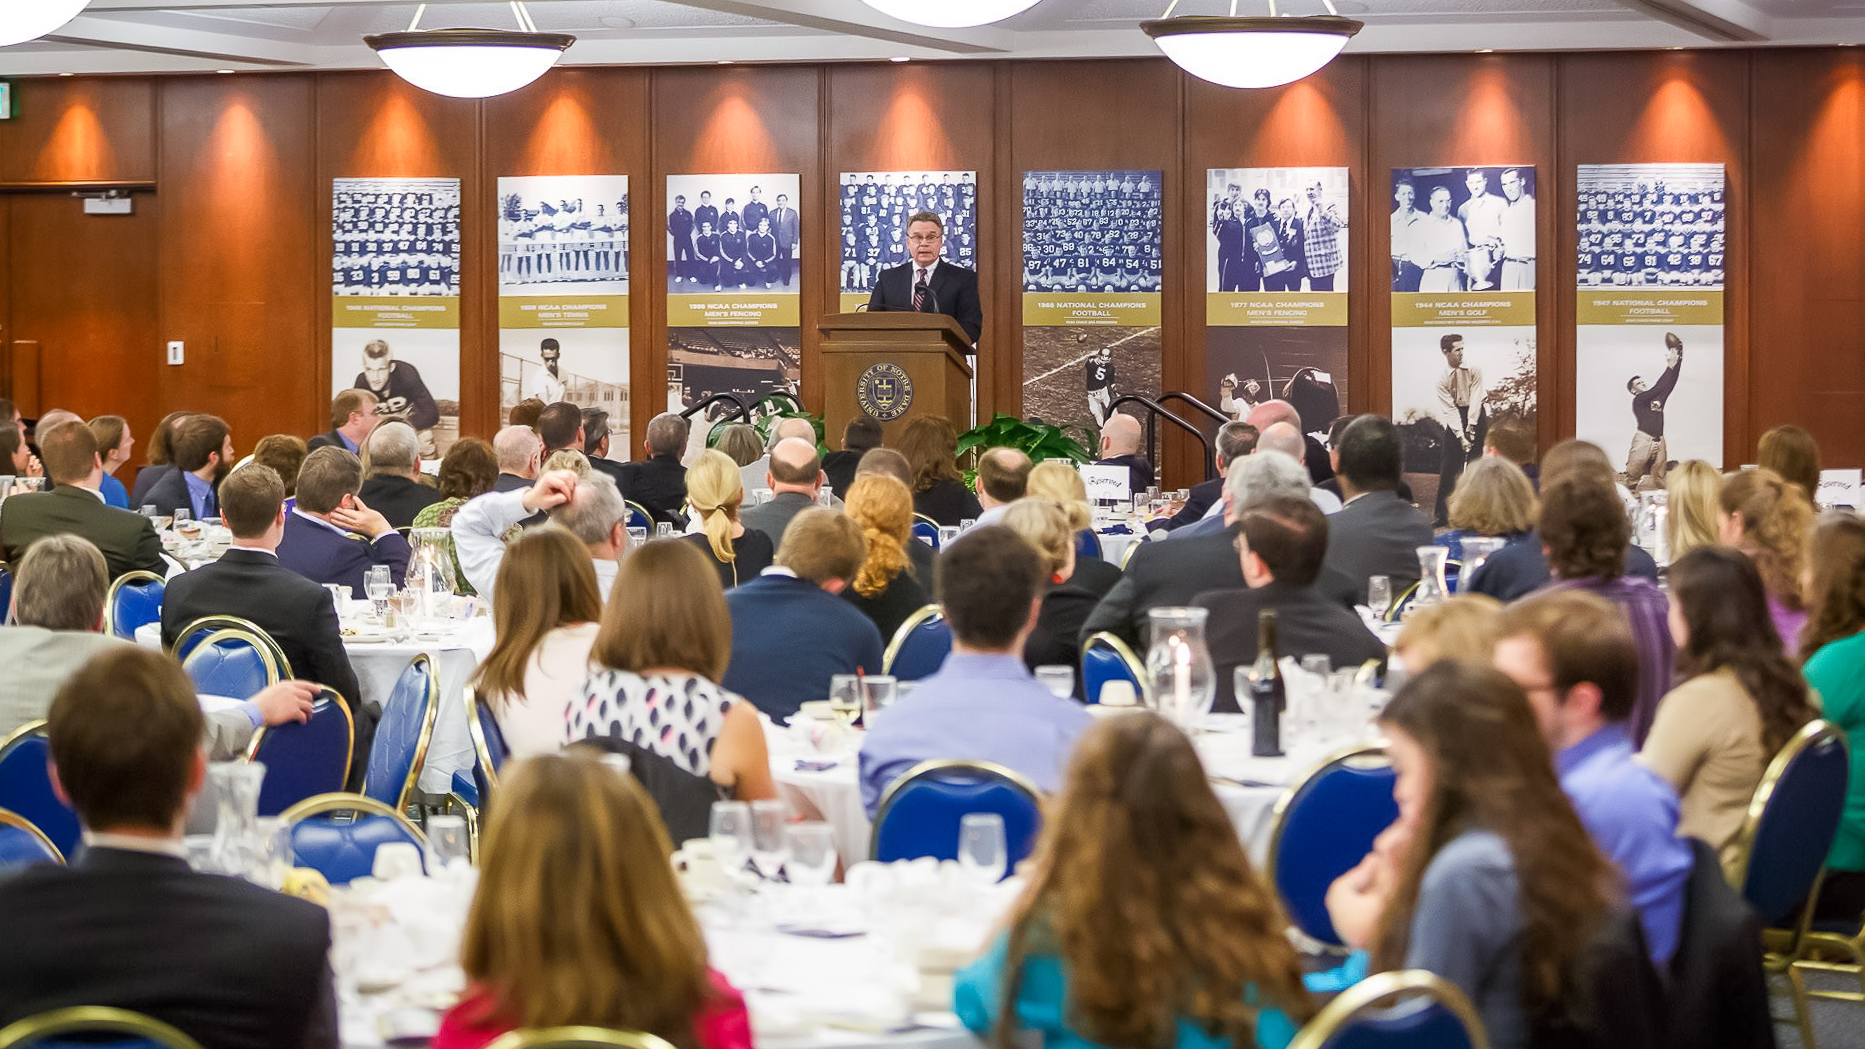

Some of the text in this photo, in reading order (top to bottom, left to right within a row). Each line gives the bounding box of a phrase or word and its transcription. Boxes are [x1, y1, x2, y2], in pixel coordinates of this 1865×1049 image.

[1615, 194, 1624, 202] 14
[1644, 212, 1652, 220] 7
[1056, 230, 1066, 238] 73
[1632, 234, 1646, 243] 73
[845, 248, 856, 257] 71
[868, 248, 880, 256] 37
[960, 248, 971, 256] 85
[1043, 245, 1054, 253] 30
[1053, 259, 1066, 268] 47
[1103, 258, 1116, 266] 64
[1126, 259, 1139, 268] 54
[1578, 254, 1592, 264] 74
[1601, 255, 1615, 265] 64
[1645, 256, 1656, 266] 81
[1667, 254, 1682, 265] 42
[1708, 256, 1723, 265] 67
[1151, 260, 1161, 269] 51
[1095, 367, 1107, 380] 5
[891, 367, 911, 391] NOTRE
[859, 369, 879, 417] UNIVERSITY
[891, 395, 911, 417] DAME
[1088, 476, 1122, 488] Reserved
